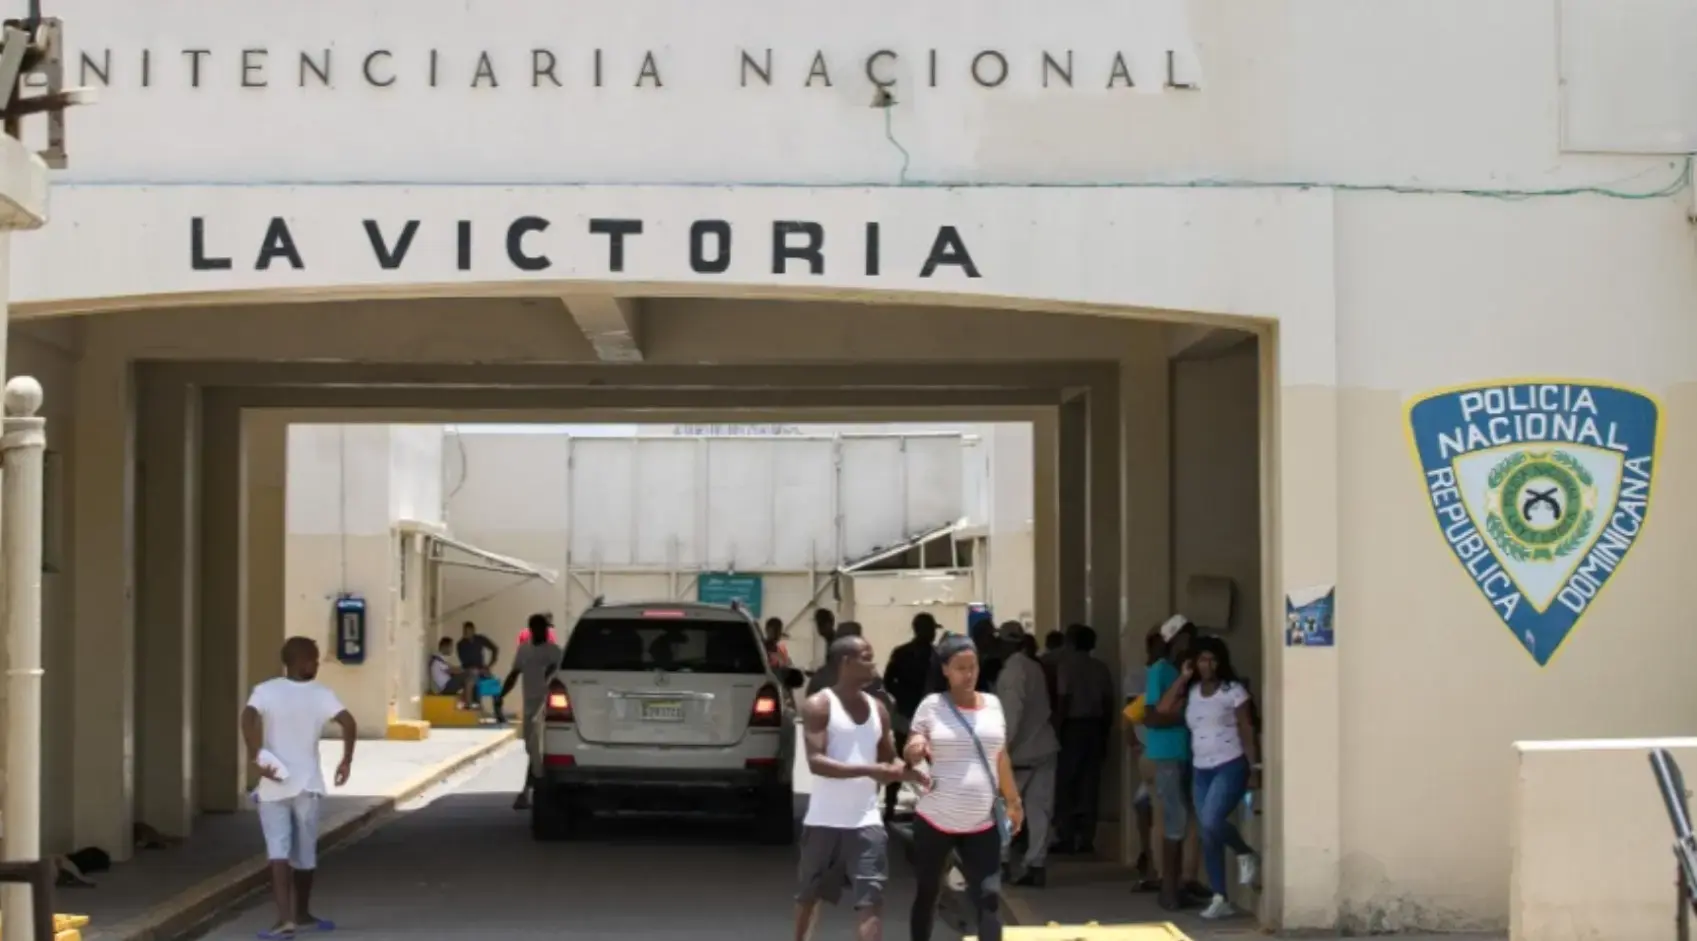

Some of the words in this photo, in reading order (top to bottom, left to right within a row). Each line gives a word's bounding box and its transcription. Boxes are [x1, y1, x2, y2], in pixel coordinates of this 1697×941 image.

[740, 48, 1198, 89] NACIONAL
[190, 216, 305, 271] LA
[362, 214, 983, 279] VICTORIA
[1459, 384, 1597, 421] POLICIA
[1437, 413, 1629, 458] NACIONAL
[1427, 466, 1521, 621] REPUBLICA
[1556, 455, 1652, 614] DOMINICANA
